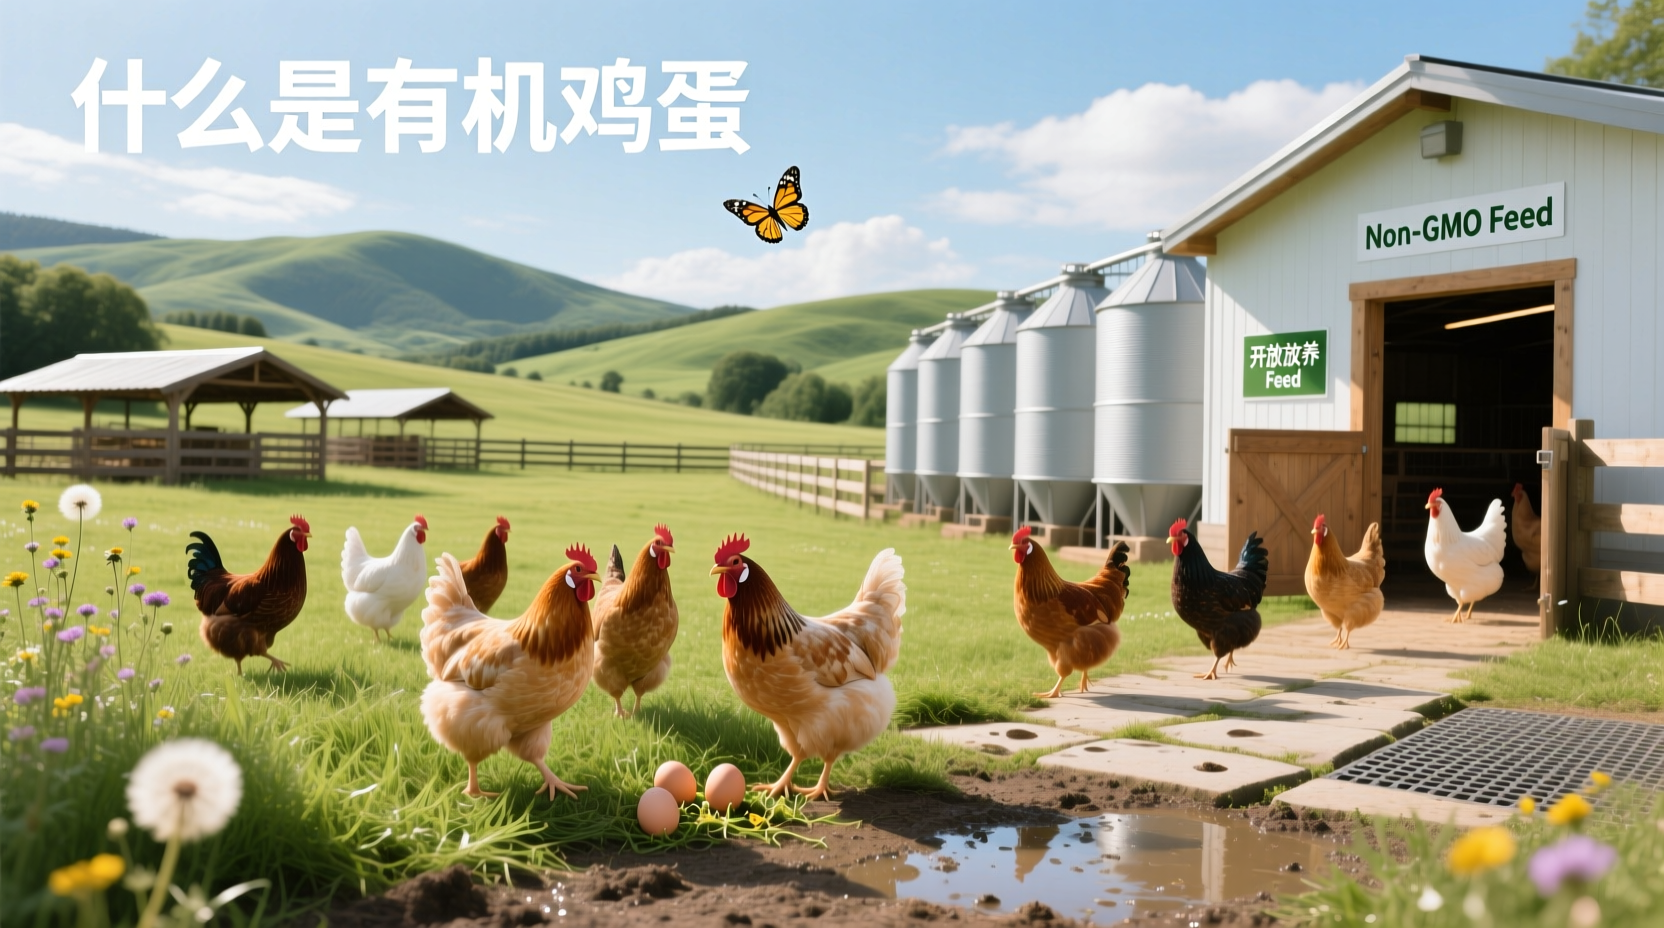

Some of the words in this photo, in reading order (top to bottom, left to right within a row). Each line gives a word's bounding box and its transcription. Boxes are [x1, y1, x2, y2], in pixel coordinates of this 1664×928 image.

[1365, 208, 1482, 250] Non-GMO
[1489, 196, 1553, 233] Feed
[1249, 340, 1320, 369] 开放放养
[1265, 368, 1302, 389] Feed
